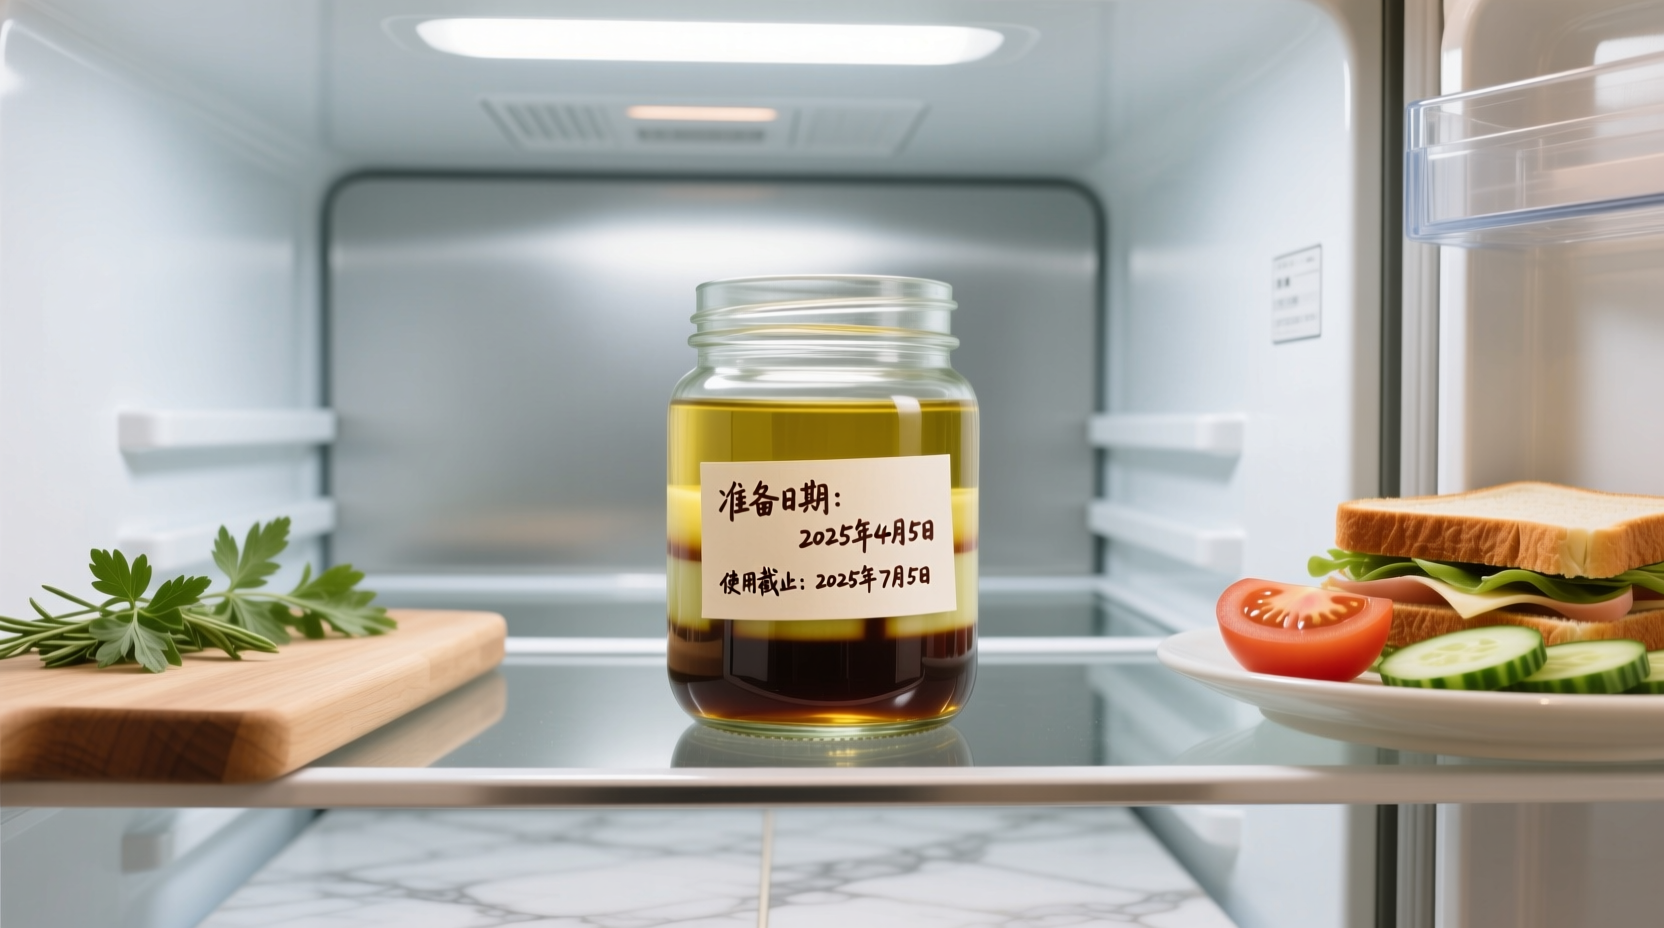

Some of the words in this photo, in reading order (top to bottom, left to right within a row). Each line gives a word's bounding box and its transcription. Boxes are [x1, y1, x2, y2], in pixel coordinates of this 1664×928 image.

[719, 480, 841, 522] 准备日期：
[798, 518, 934, 553] 2025年4月5日
